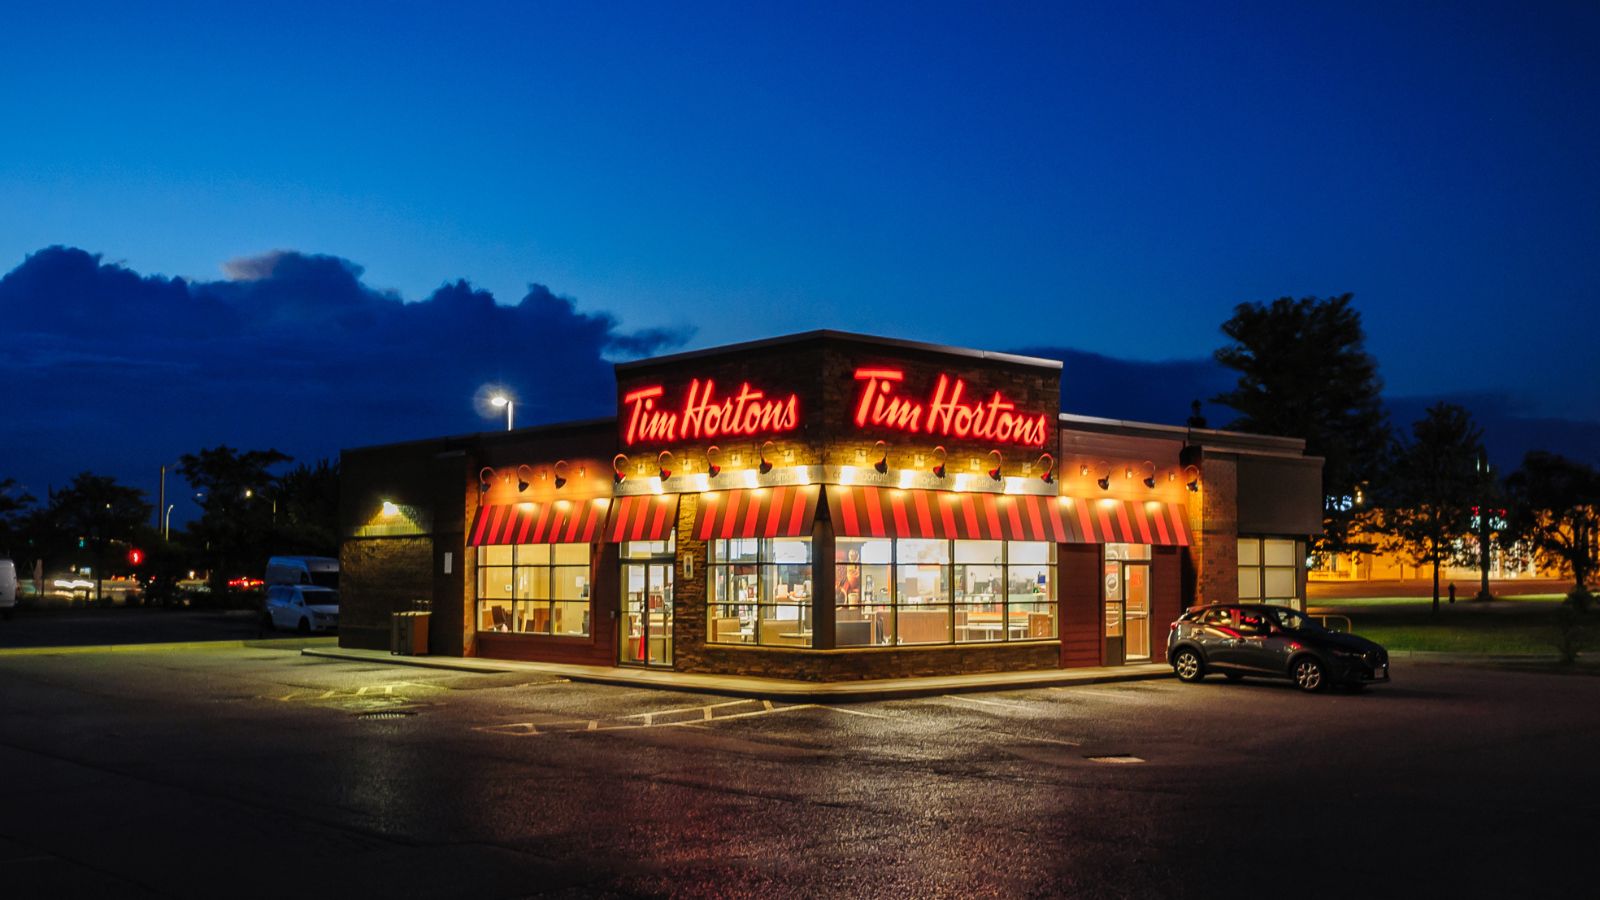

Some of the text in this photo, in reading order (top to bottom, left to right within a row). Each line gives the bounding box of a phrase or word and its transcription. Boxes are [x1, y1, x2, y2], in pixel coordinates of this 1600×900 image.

[624, 377, 799, 445] Tim Hortons
[854, 367, 1048, 447] Tim Hortons
